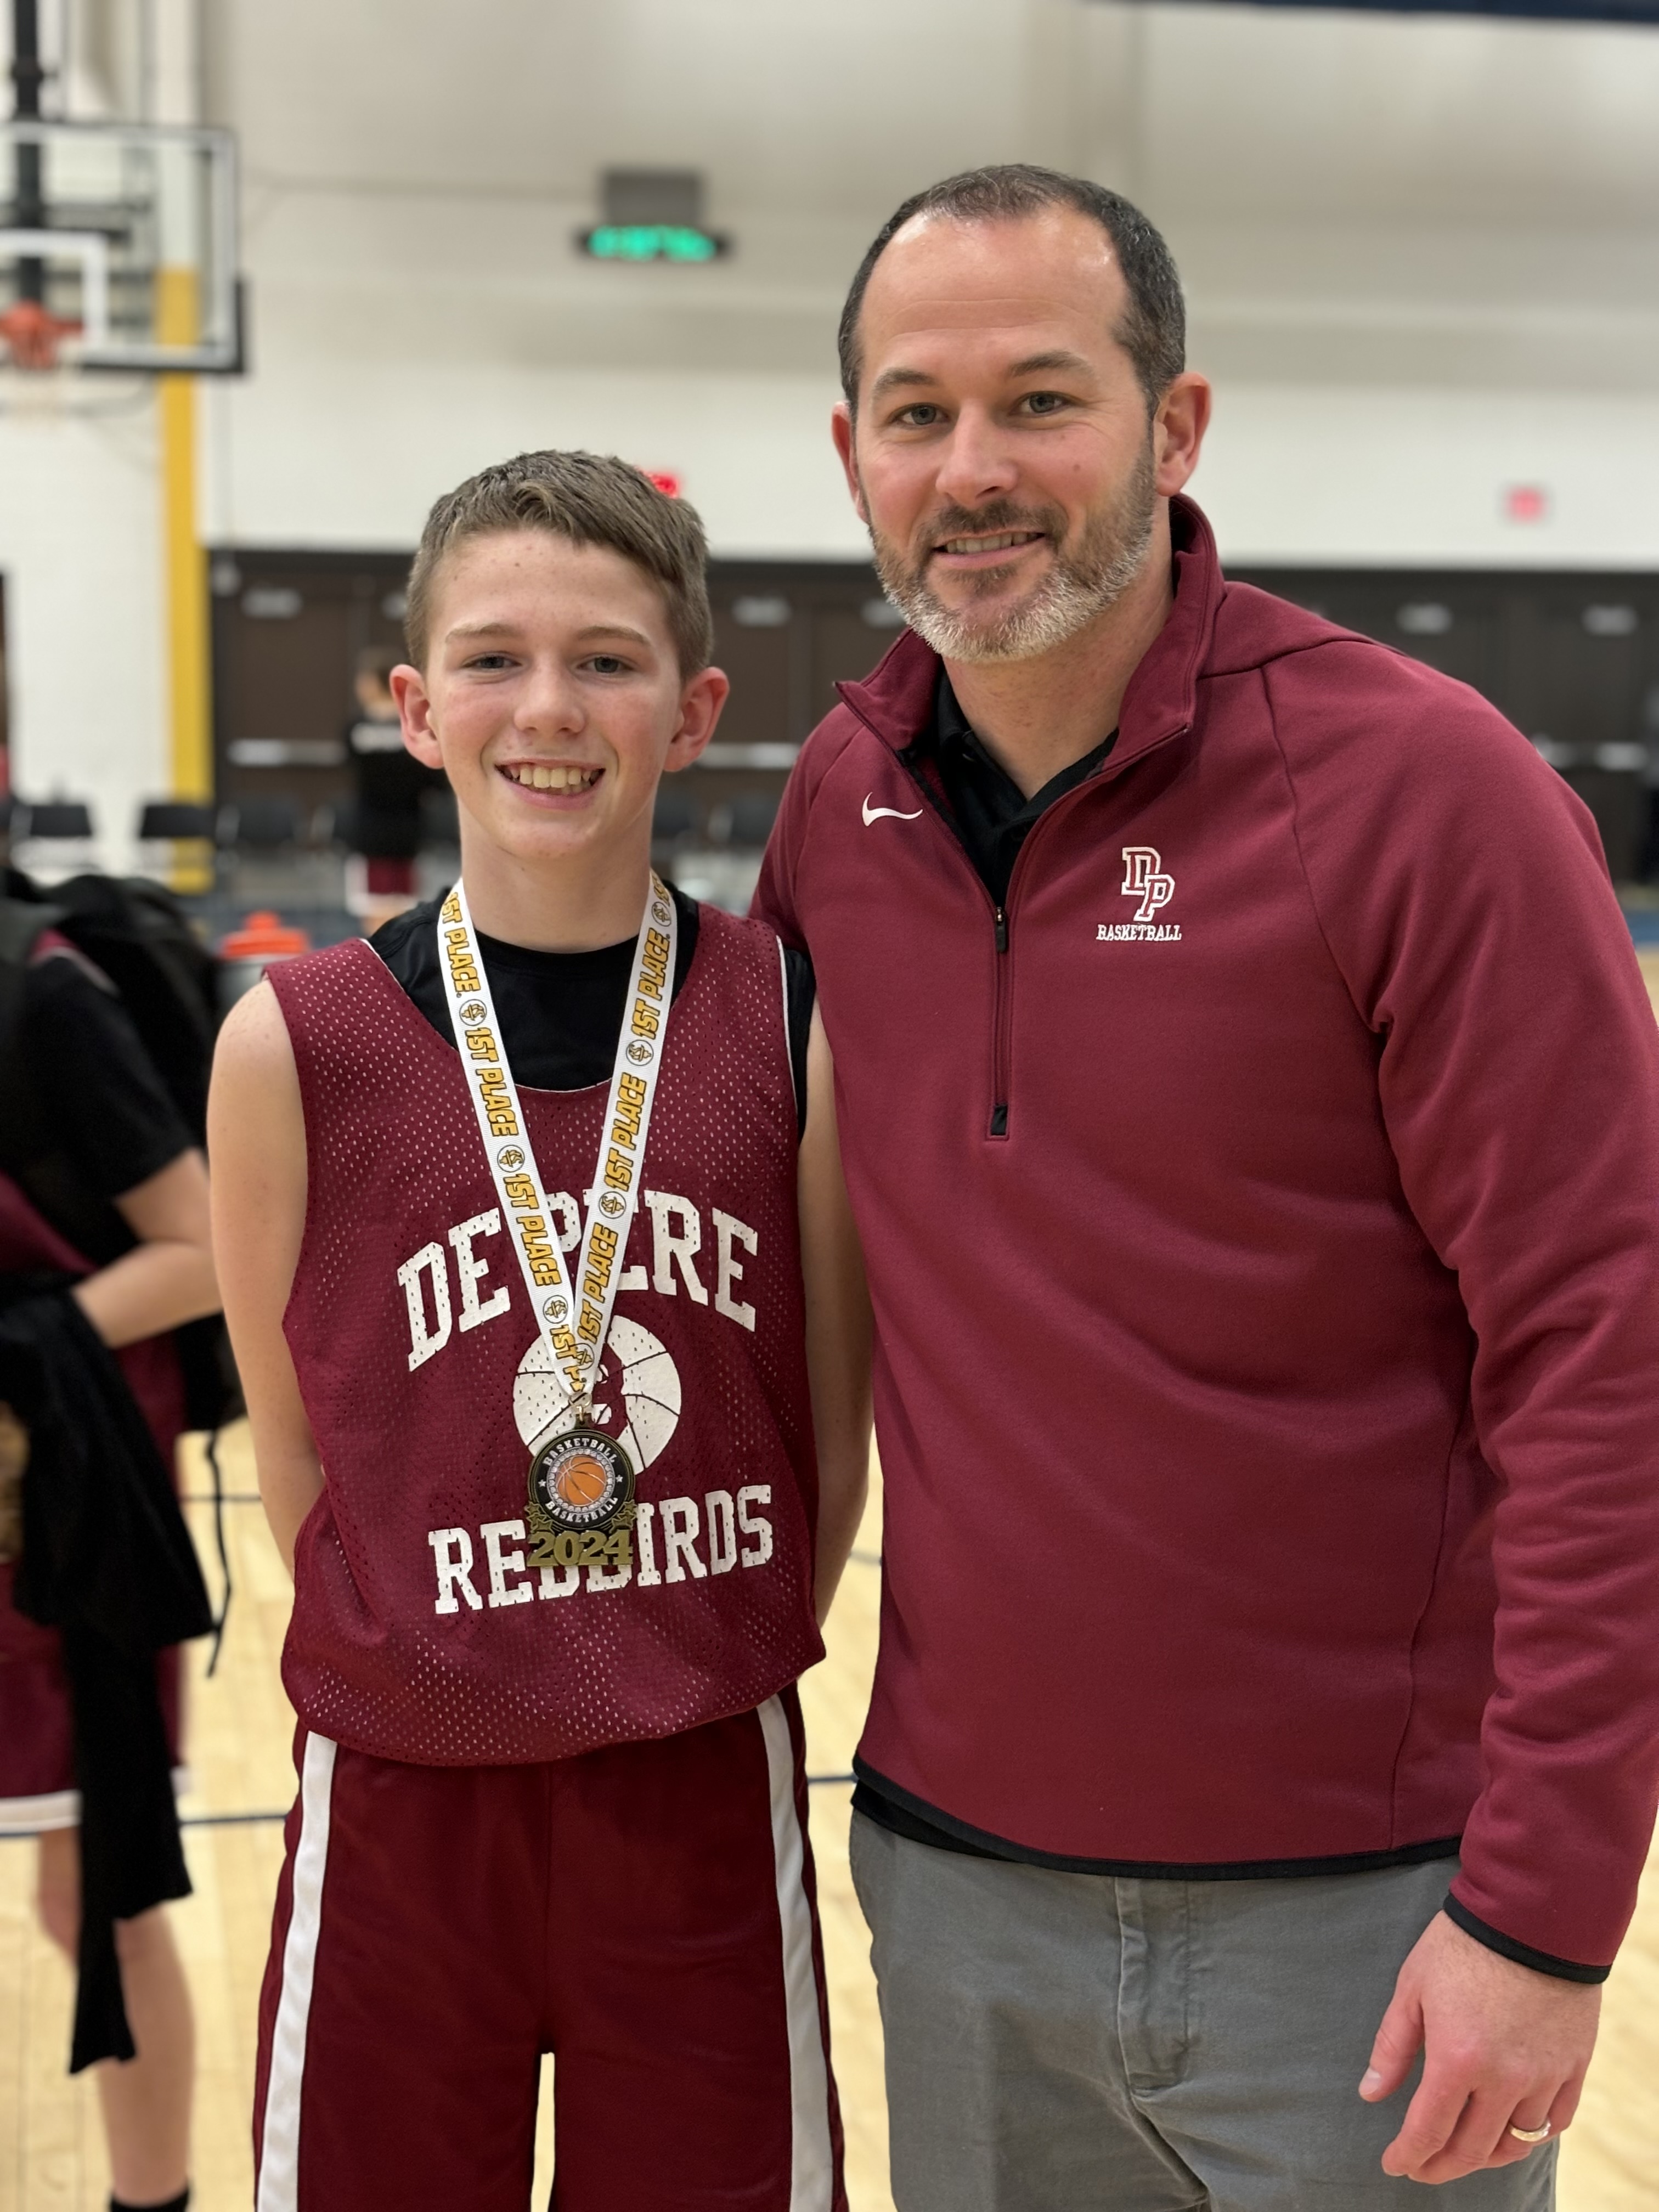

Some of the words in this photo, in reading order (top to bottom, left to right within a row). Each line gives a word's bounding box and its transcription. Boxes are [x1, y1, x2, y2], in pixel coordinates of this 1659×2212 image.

[1121, 847, 1175, 922] DP
[1096, 924, 1182, 941] BASKETBALL
[444, 927, 481, 992] PLACE
[637, 927, 670, 1001] PLACE
[631, 998, 660, 1040] 1ST
[465, 1027, 499, 1062] 1ST
[476, 1068, 519, 1137] PLACE
[611, 1072, 647, 1150] PLACE
[503, 1173, 539, 1210] 1ST
[604, 1147, 634, 1192] 1ST
[516, 1215, 562, 1286] PLACE
[583, 1222, 619, 1304] PLACE
[397, 1207, 511, 1372] DE
[578, 1299, 603, 1345] 1ST
[542, 1437, 619, 1467] BASKETBALL
[545, 1497, 619, 1523] BASKETBALL
[527, 1528, 634, 1567] 2024
